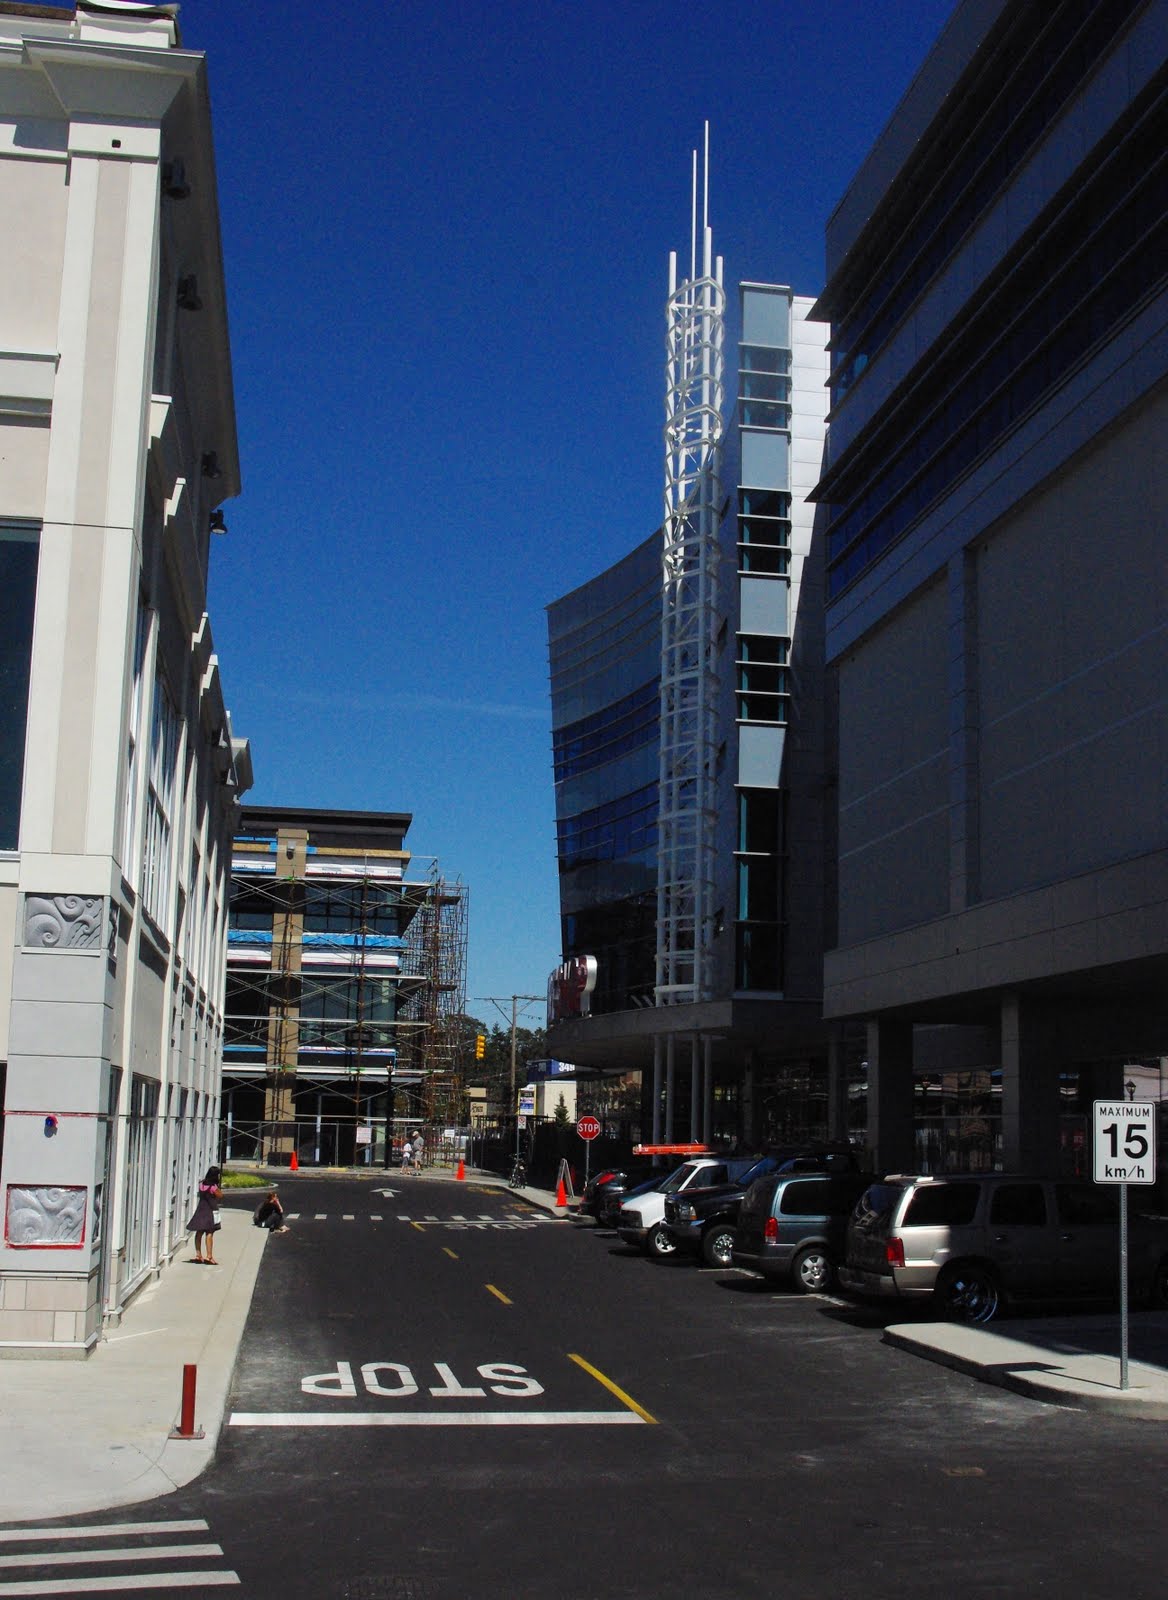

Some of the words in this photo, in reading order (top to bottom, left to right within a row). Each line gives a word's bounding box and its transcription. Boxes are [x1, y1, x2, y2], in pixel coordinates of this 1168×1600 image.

[1100, 1107, 1150, 1117] MAXIMUM
[578, 1123, 600, 1133] STOP
[1102, 1123, 1149, 1159] 15
[1105, 1165, 1145, 1179] km/h
[301, 1361, 545, 1397] STOP
